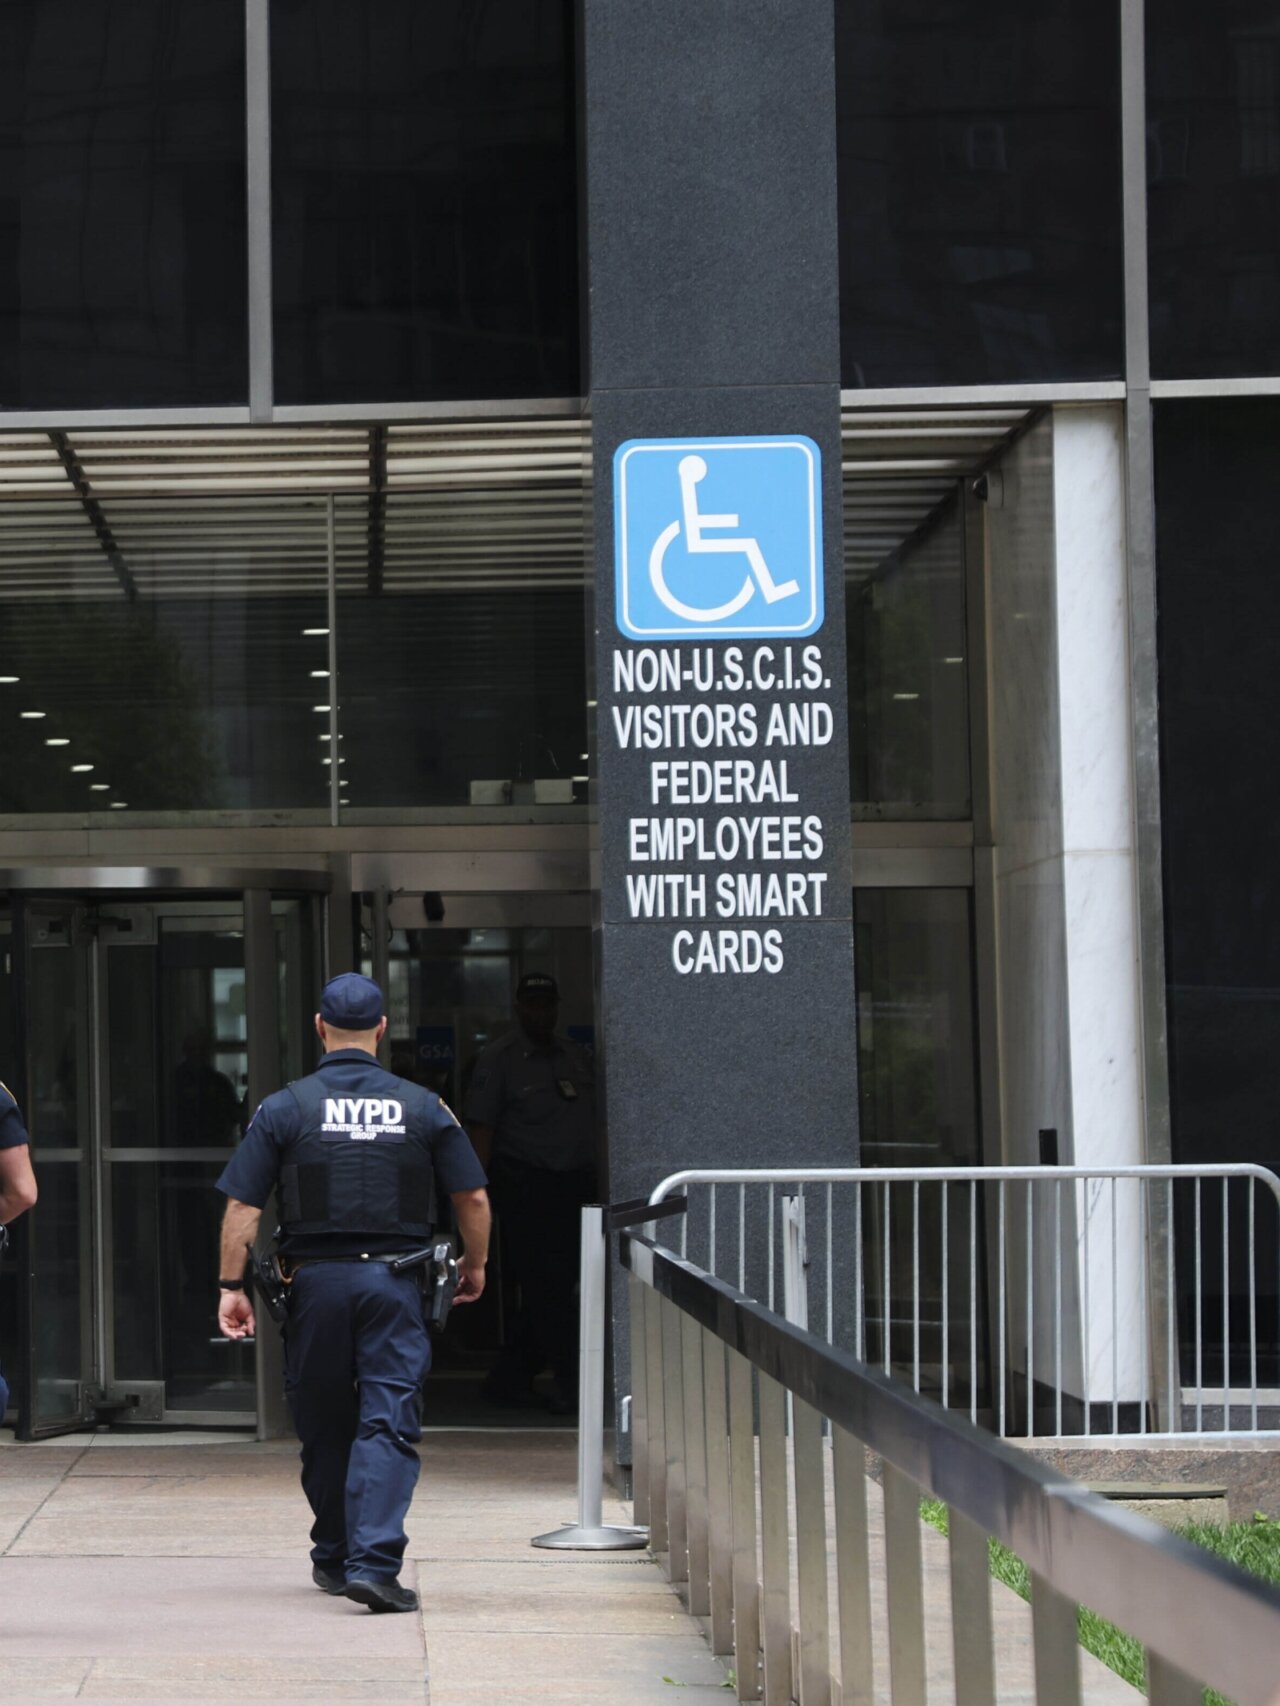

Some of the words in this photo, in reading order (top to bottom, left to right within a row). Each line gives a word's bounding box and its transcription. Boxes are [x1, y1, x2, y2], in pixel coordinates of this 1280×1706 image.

[613, 646, 831, 692] NON-U.S.C.I.S.
[612, 704, 758, 749] VISITORS
[765, 703, 834, 746] AND
[651, 760, 799, 804] FEDERAL
[629, 815, 823, 861] EMPLOYEES
[626, 874, 706, 917] WITH
[716, 873, 827, 917] SMART
[673, 929, 784, 974] CARDS
[419, 1044, 453, 1058] GSA
[322, 1123, 363, 1132] STRATEGIC
[365, 1124, 406, 1134] RESPONSE
[325, 1098, 402, 1125] NYPD
[350, 1131, 377, 1140] GROUP
